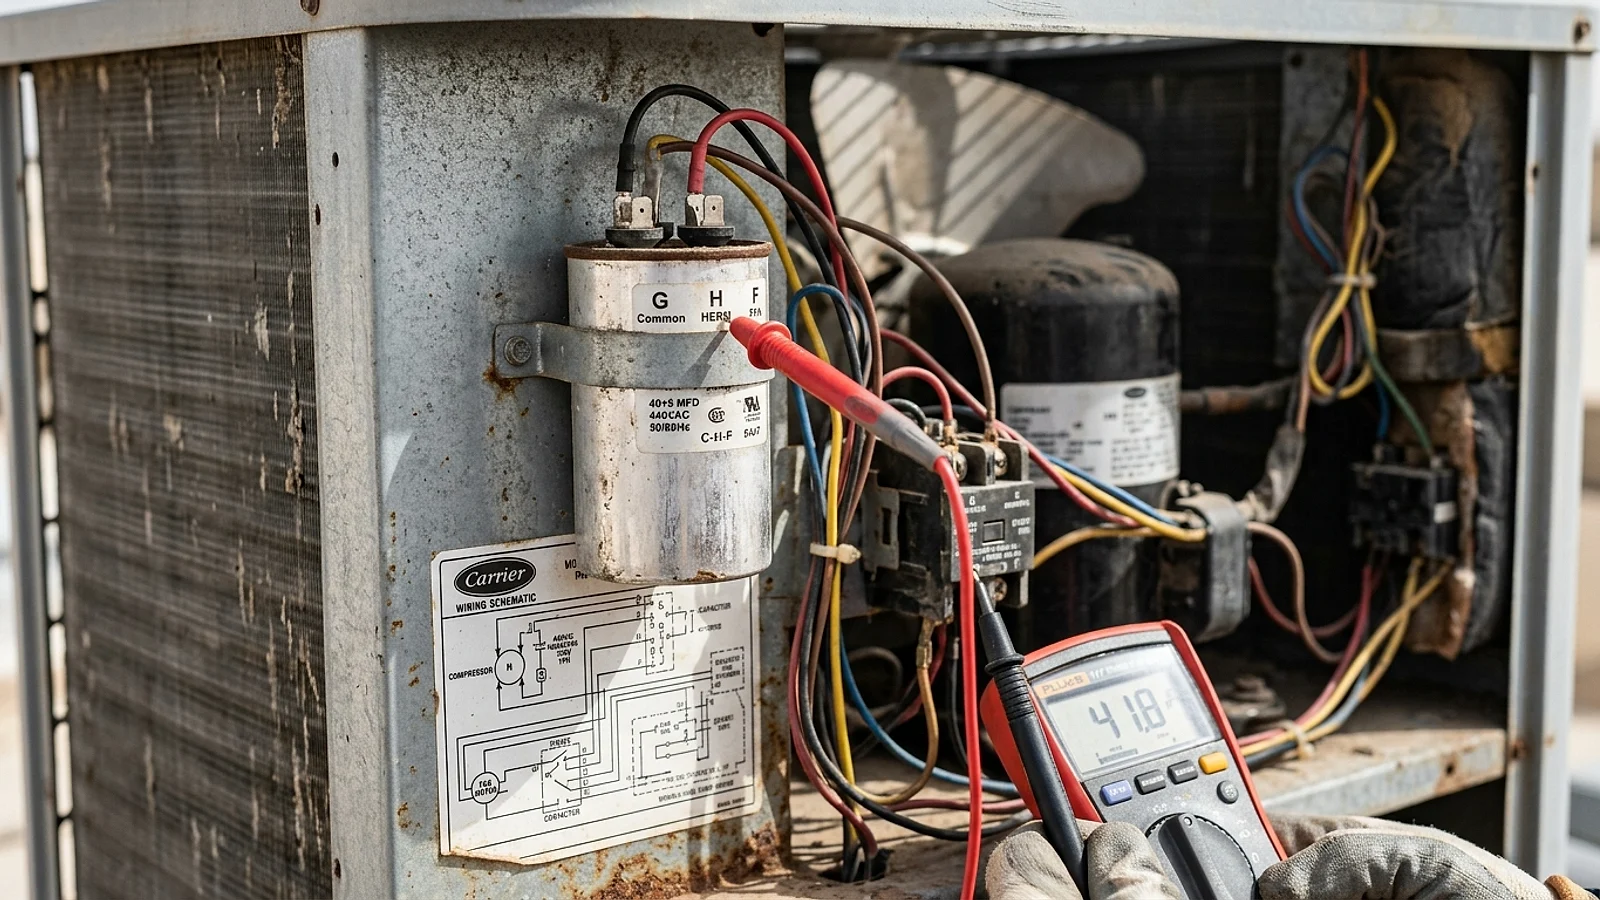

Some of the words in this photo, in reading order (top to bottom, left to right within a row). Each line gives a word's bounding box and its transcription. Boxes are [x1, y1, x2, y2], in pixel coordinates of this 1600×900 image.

[652, 291, 669, 310] G
[709, 290, 723, 308] H
[752, 287, 759, 304] F
[637, 313, 686, 324] Common
[676, 397, 700, 408] MFD
[465, 567, 527, 588] Carrier
[456, 600, 487, 613] WIRING
[489, 592, 537, 609] SCHEMATIC
[448, 667, 494, 680] COMPRESSOR
